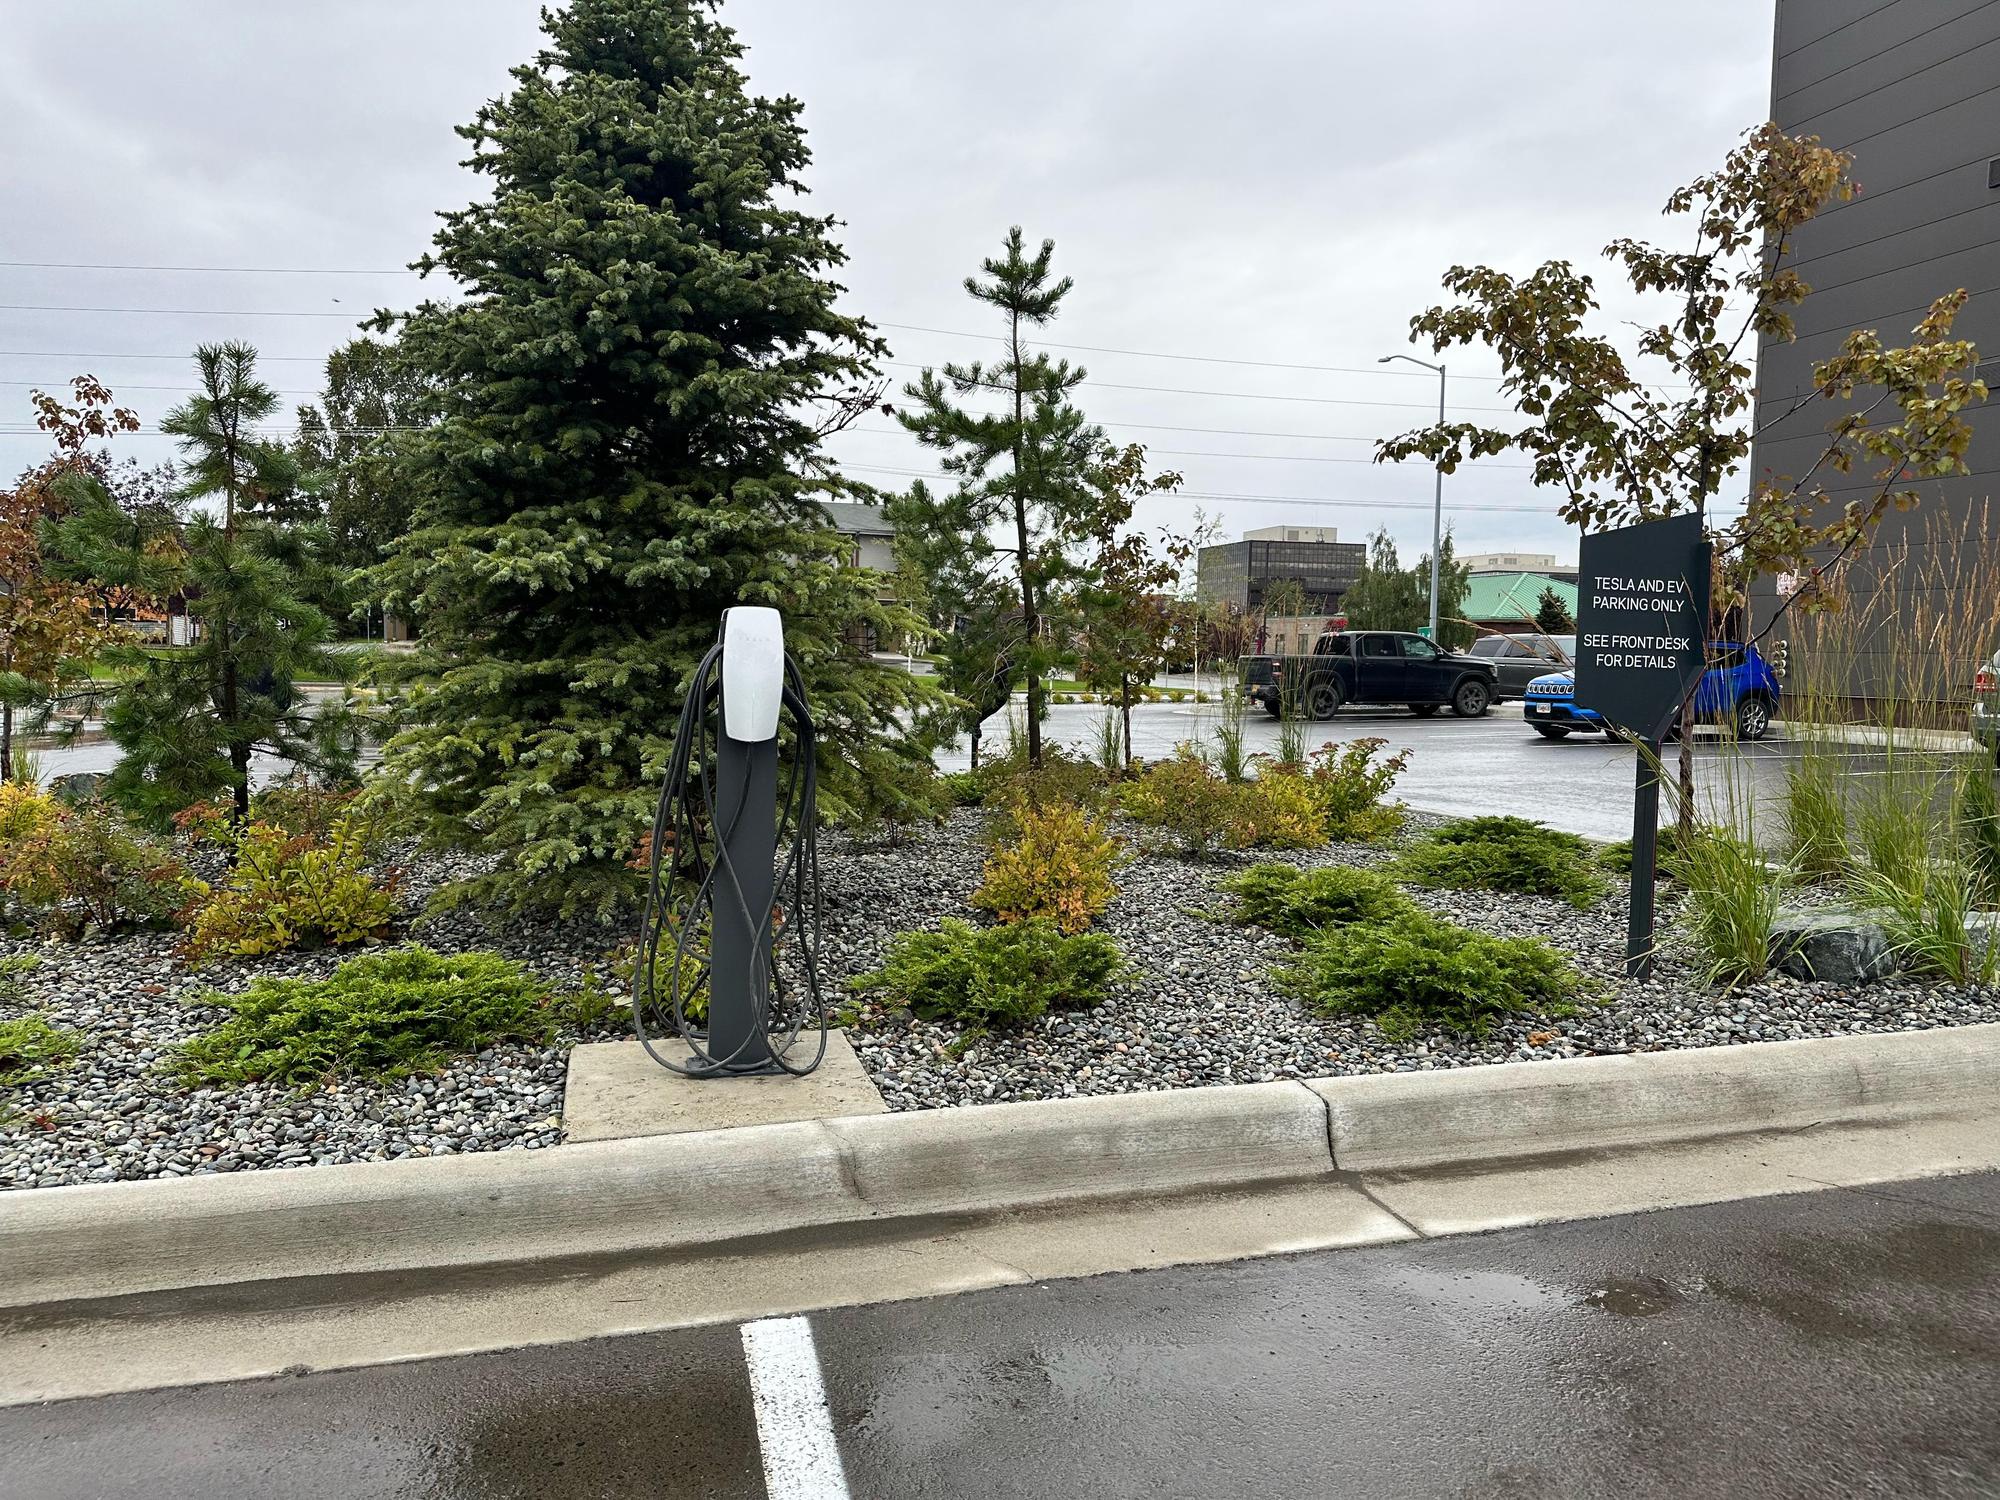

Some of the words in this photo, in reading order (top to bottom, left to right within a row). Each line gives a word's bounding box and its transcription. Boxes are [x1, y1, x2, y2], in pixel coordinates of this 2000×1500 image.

[1594, 576, 1636, 592] TESLA
[1637, 578, 1665, 593] AND
[1667, 579, 1685, 594] EV
[1593, 595, 1648, 611] PARKING
[1651, 598, 1685, 613] ONLY
[1583, 633, 1609, 648] SEE
[1611, 635, 1654, 650] FRONT
[1655, 636, 1690, 651] DESK
[1596, 653, 1622, 668] FOR
[1625, 655, 1676, 669] DETAILS
